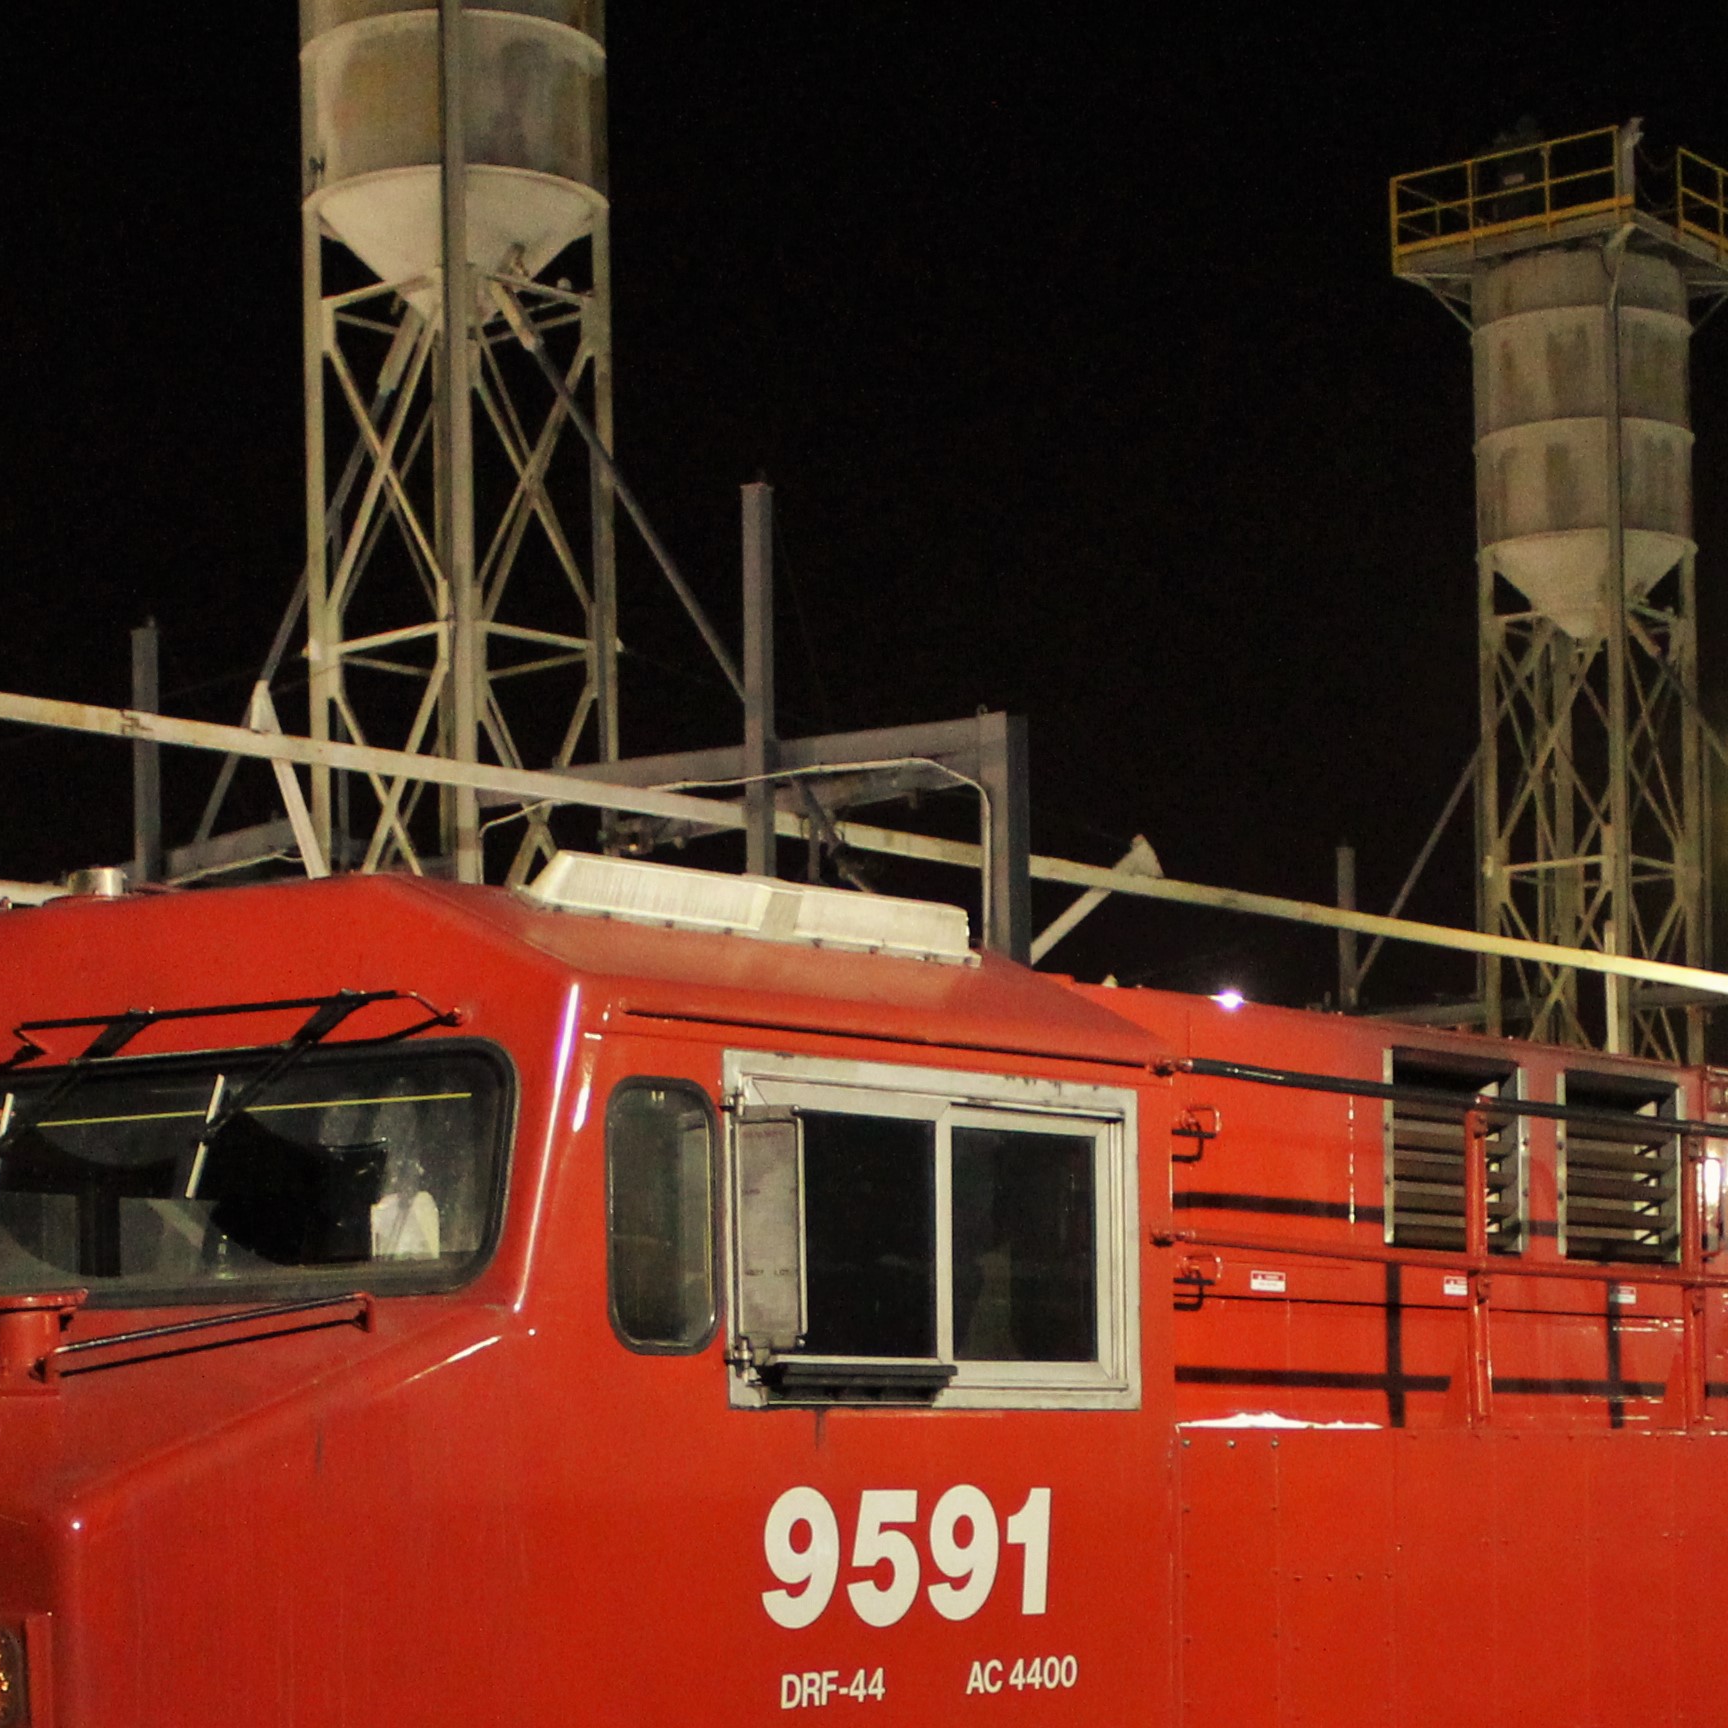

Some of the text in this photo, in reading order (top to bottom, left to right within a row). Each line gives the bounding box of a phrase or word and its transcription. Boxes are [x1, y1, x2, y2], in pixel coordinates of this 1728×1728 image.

[761, 1483, 1052, 1630] 9591
[780, 1666, 886, 1710] DRF-44
[965, 1654, 1078, 1695] AC 4400
